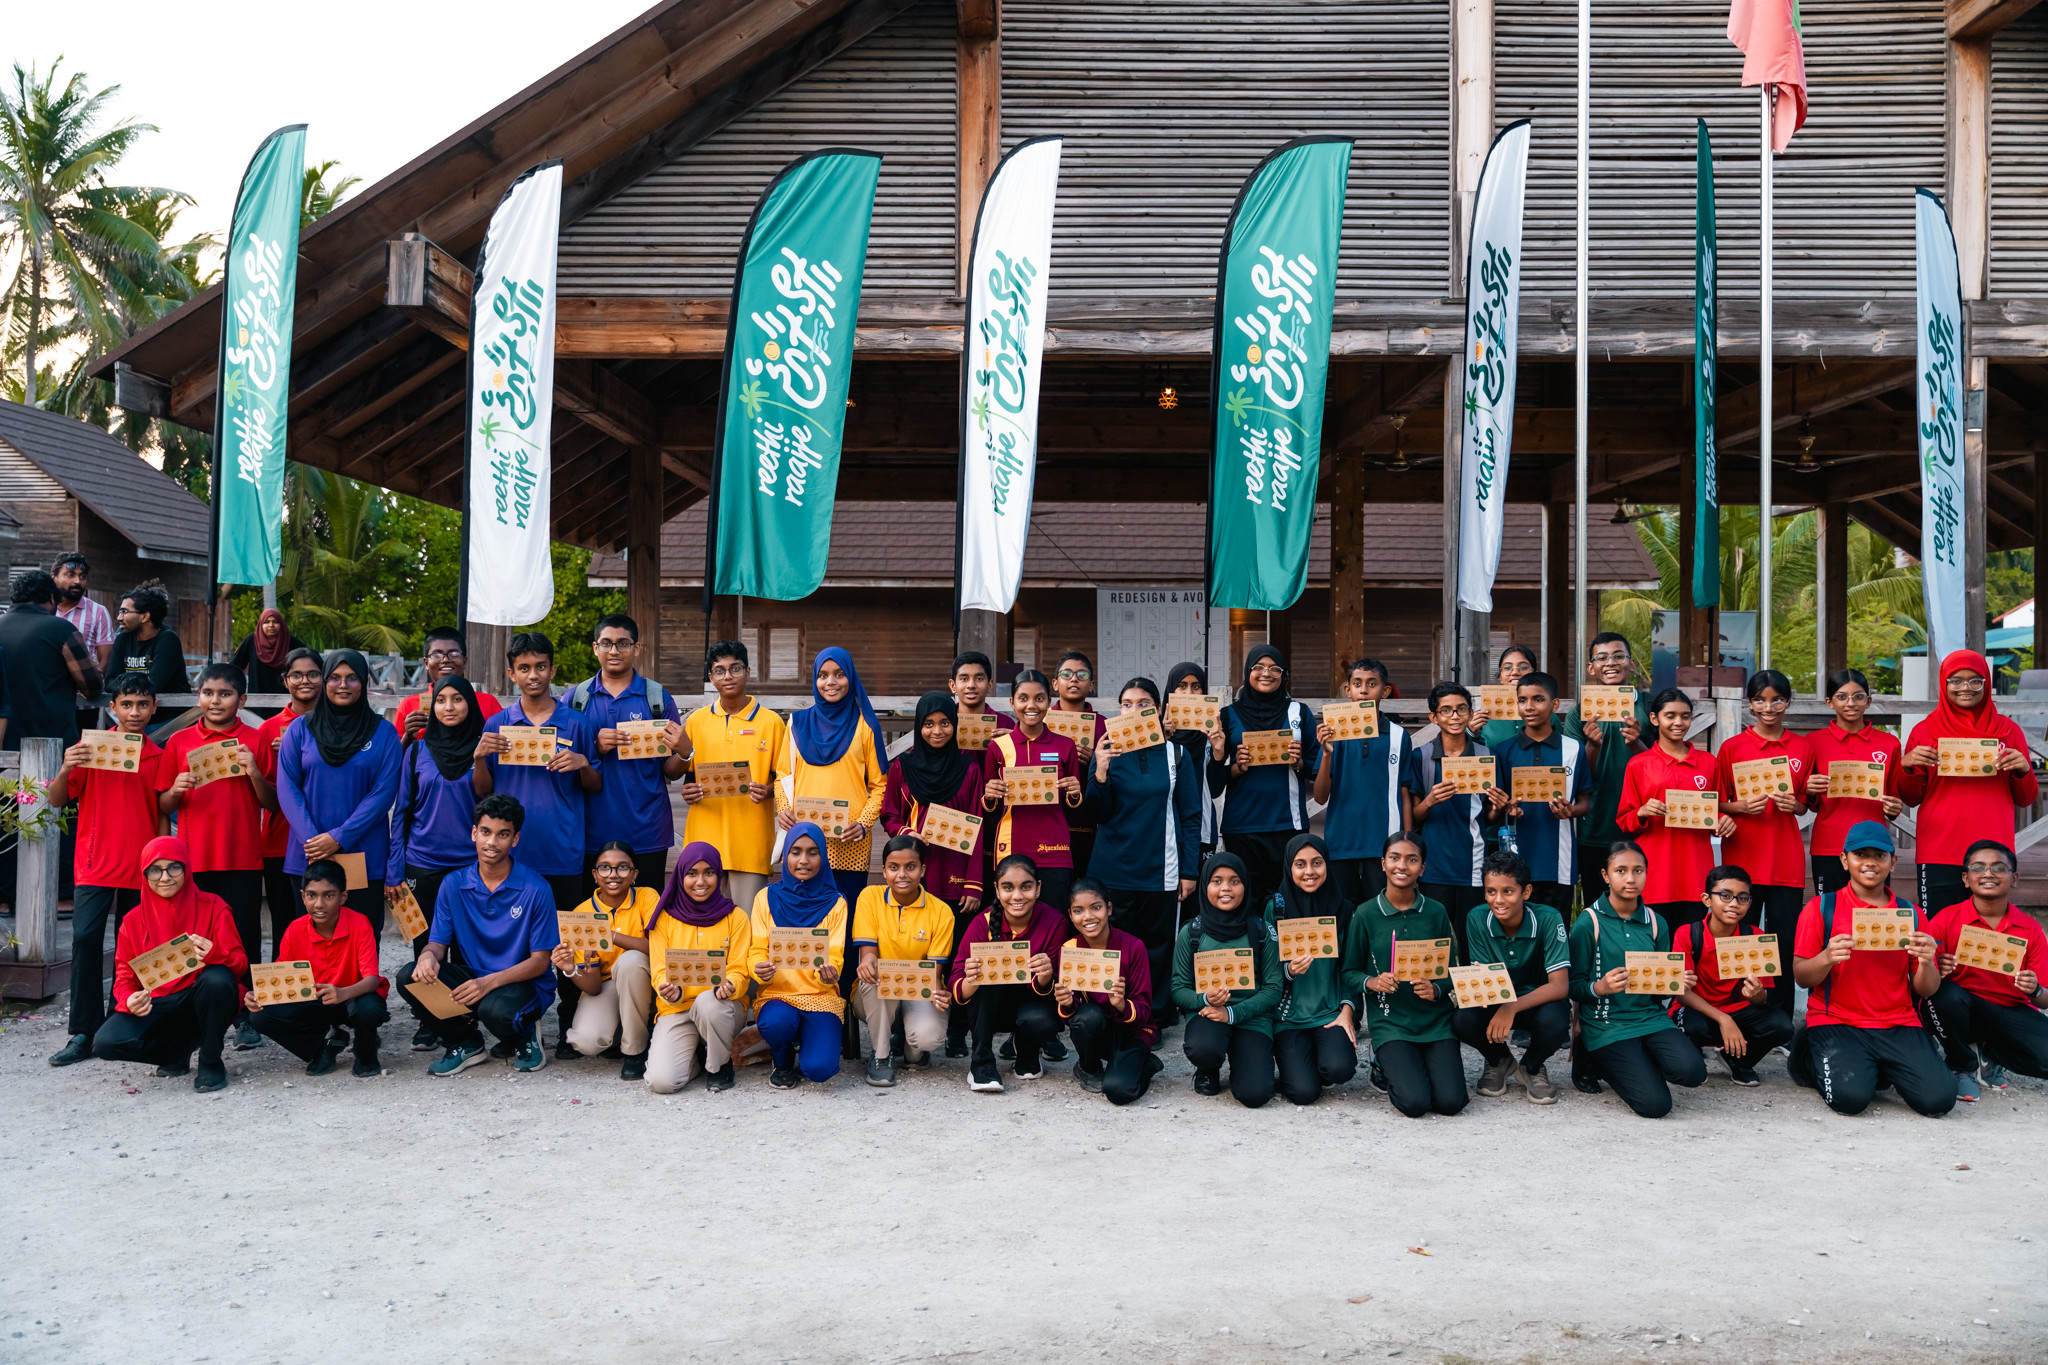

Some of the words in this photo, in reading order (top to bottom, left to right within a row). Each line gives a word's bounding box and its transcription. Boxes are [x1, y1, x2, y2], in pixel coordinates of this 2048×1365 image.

[490, 448, 510, 525] reethi
[510, 448, 537, 530] raajje
[754, 417, 784, 496] reethi
[784, 425, 823, 506] raajje
[988, 432, 1023, 516] raajje
[1240, 424, 1267, 504] reethi
[1268, 427, 1301, 512] raajje
[1111, 592, 1166, 603] REDESIGN
[1171, 592, 1178, 603] &
[1183, 592, 1203, 602] AVO
[1928, 1000, 1947, 1038] SCHOOL
